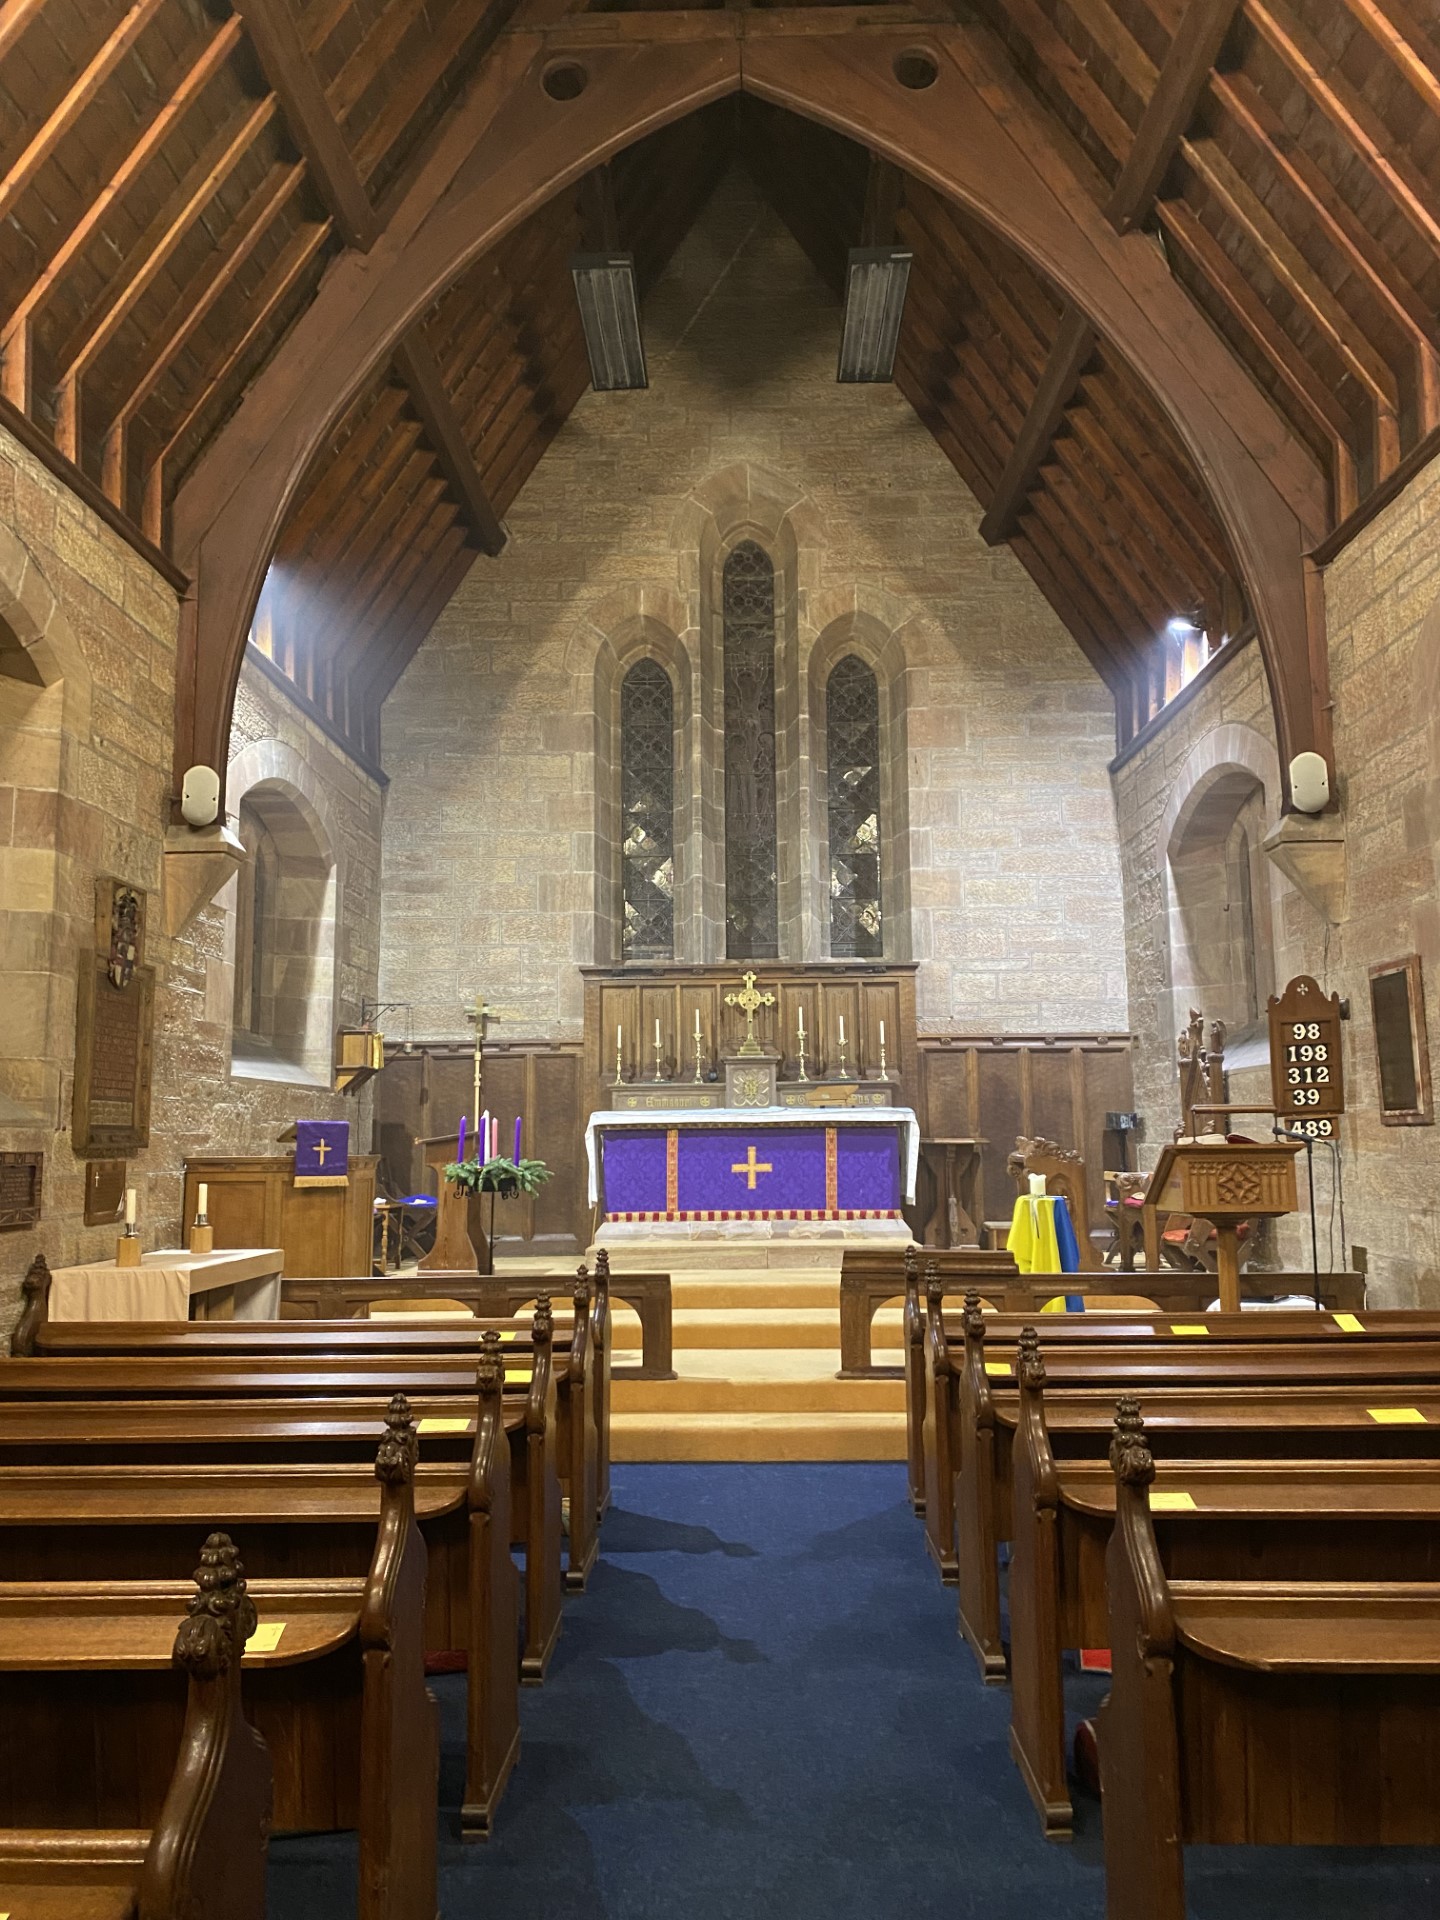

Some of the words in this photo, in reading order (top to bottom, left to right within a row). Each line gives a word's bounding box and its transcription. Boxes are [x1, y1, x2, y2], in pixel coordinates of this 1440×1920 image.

[1292, 1023, 1321, 1040] 98
[1288, 1044, 1328, 1062] 198
[1288, 1066, 1330, 1084] 312
[1293, 1088, 1320, 1106] 39
[1291, 1119, 1333, 1137] 489
